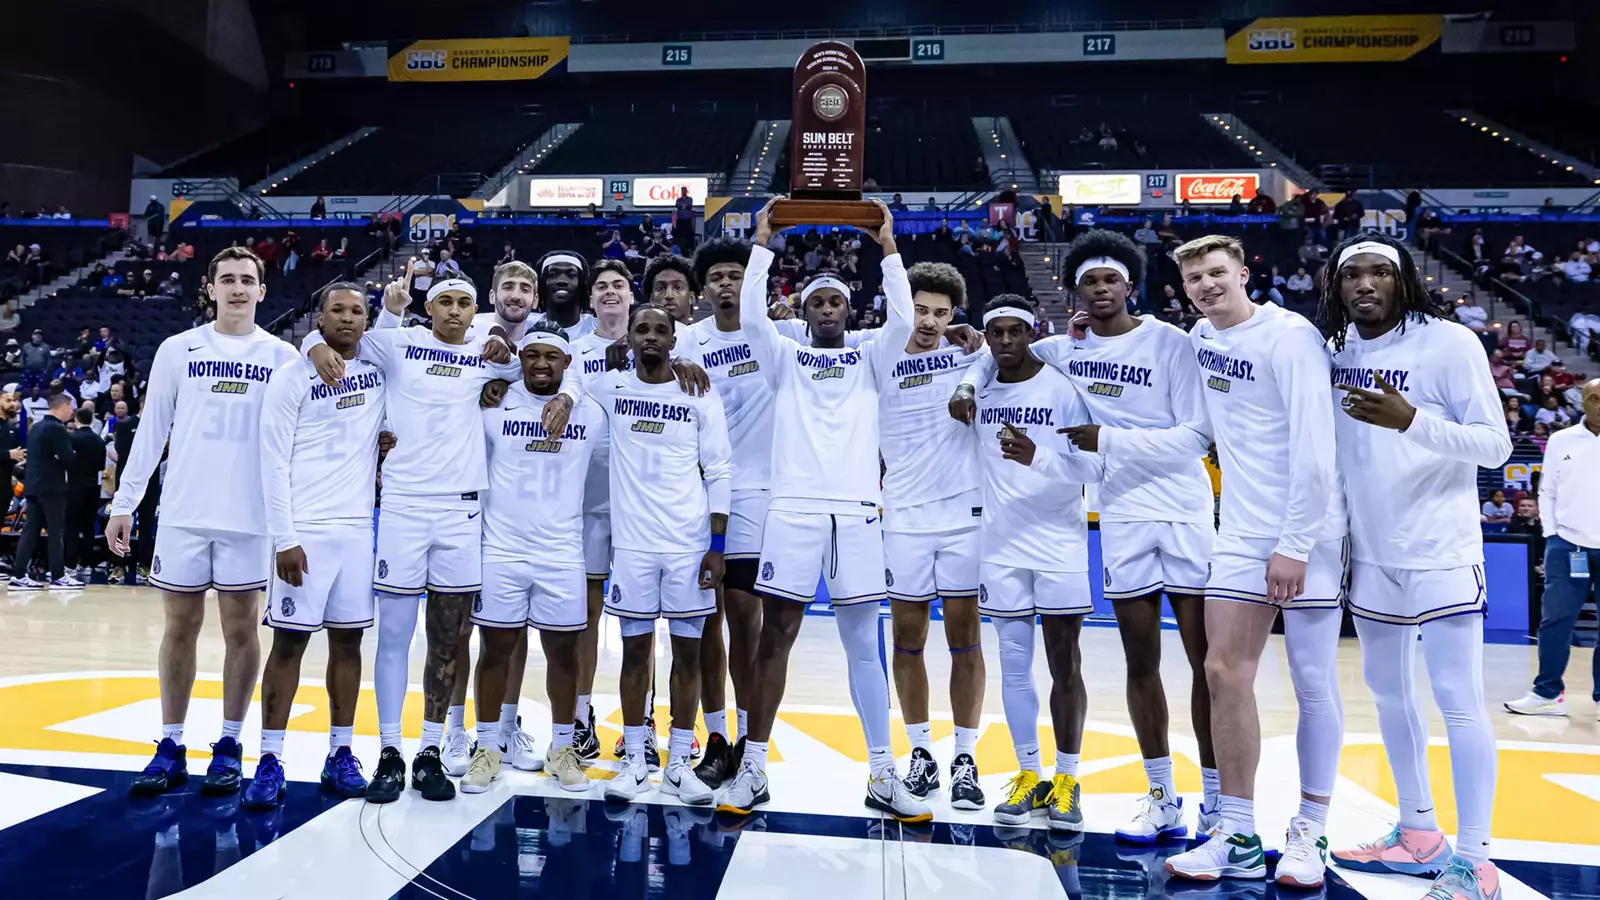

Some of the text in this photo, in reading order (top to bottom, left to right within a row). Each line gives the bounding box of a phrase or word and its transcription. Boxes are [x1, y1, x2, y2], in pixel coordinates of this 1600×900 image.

[1087, 38, 1111, 51] 217
[1303, 34, 1419, 49] CHAMPIONSHIP
[666, 49, 689, 61] 215
[917, 44, 940, 56] 216
[405, 49, 447, 71] SBC
[452, 55, 549, 69] CHAMPIONSHIP
[802, 132, 855, 144] SUN BELT
[612, 182, 627, 192] 215
[1149, 176, 1165, 186] 217
[405, 345, 458, 364] NOTHING
[702, 343, 752, 369] NOTHING
[926, 354, 958, 371] EASY.
[188, 361, 243, 379] NOTHING
[426, 364, 462, 378] JMU
[728, 360, 760, 378] JMU
[812, 367, 846, 381] JMU
[1069, 360, 1153, 388] NOTHING EASY.
[1227, 358, 1255, 382] EASY.
[211, 381, 249, 394] JMU
[357, 371, 382, 390] EASY.
[899, 373, 933, 389] JMU
[1207, 375, 1231, 394] JMU
[1087, 382, 1124, 398] JMU
[336, 393, 365, 410] JMU
[614, 398, 692, 423] NOTHING EASY.
[980, 407, 1054, 426] NOTHING EASY.
[502, 420, 550, 438] NOTHIN
[631, 420, 665, 434] JMU
[525, 440, 563, 454] JMU
